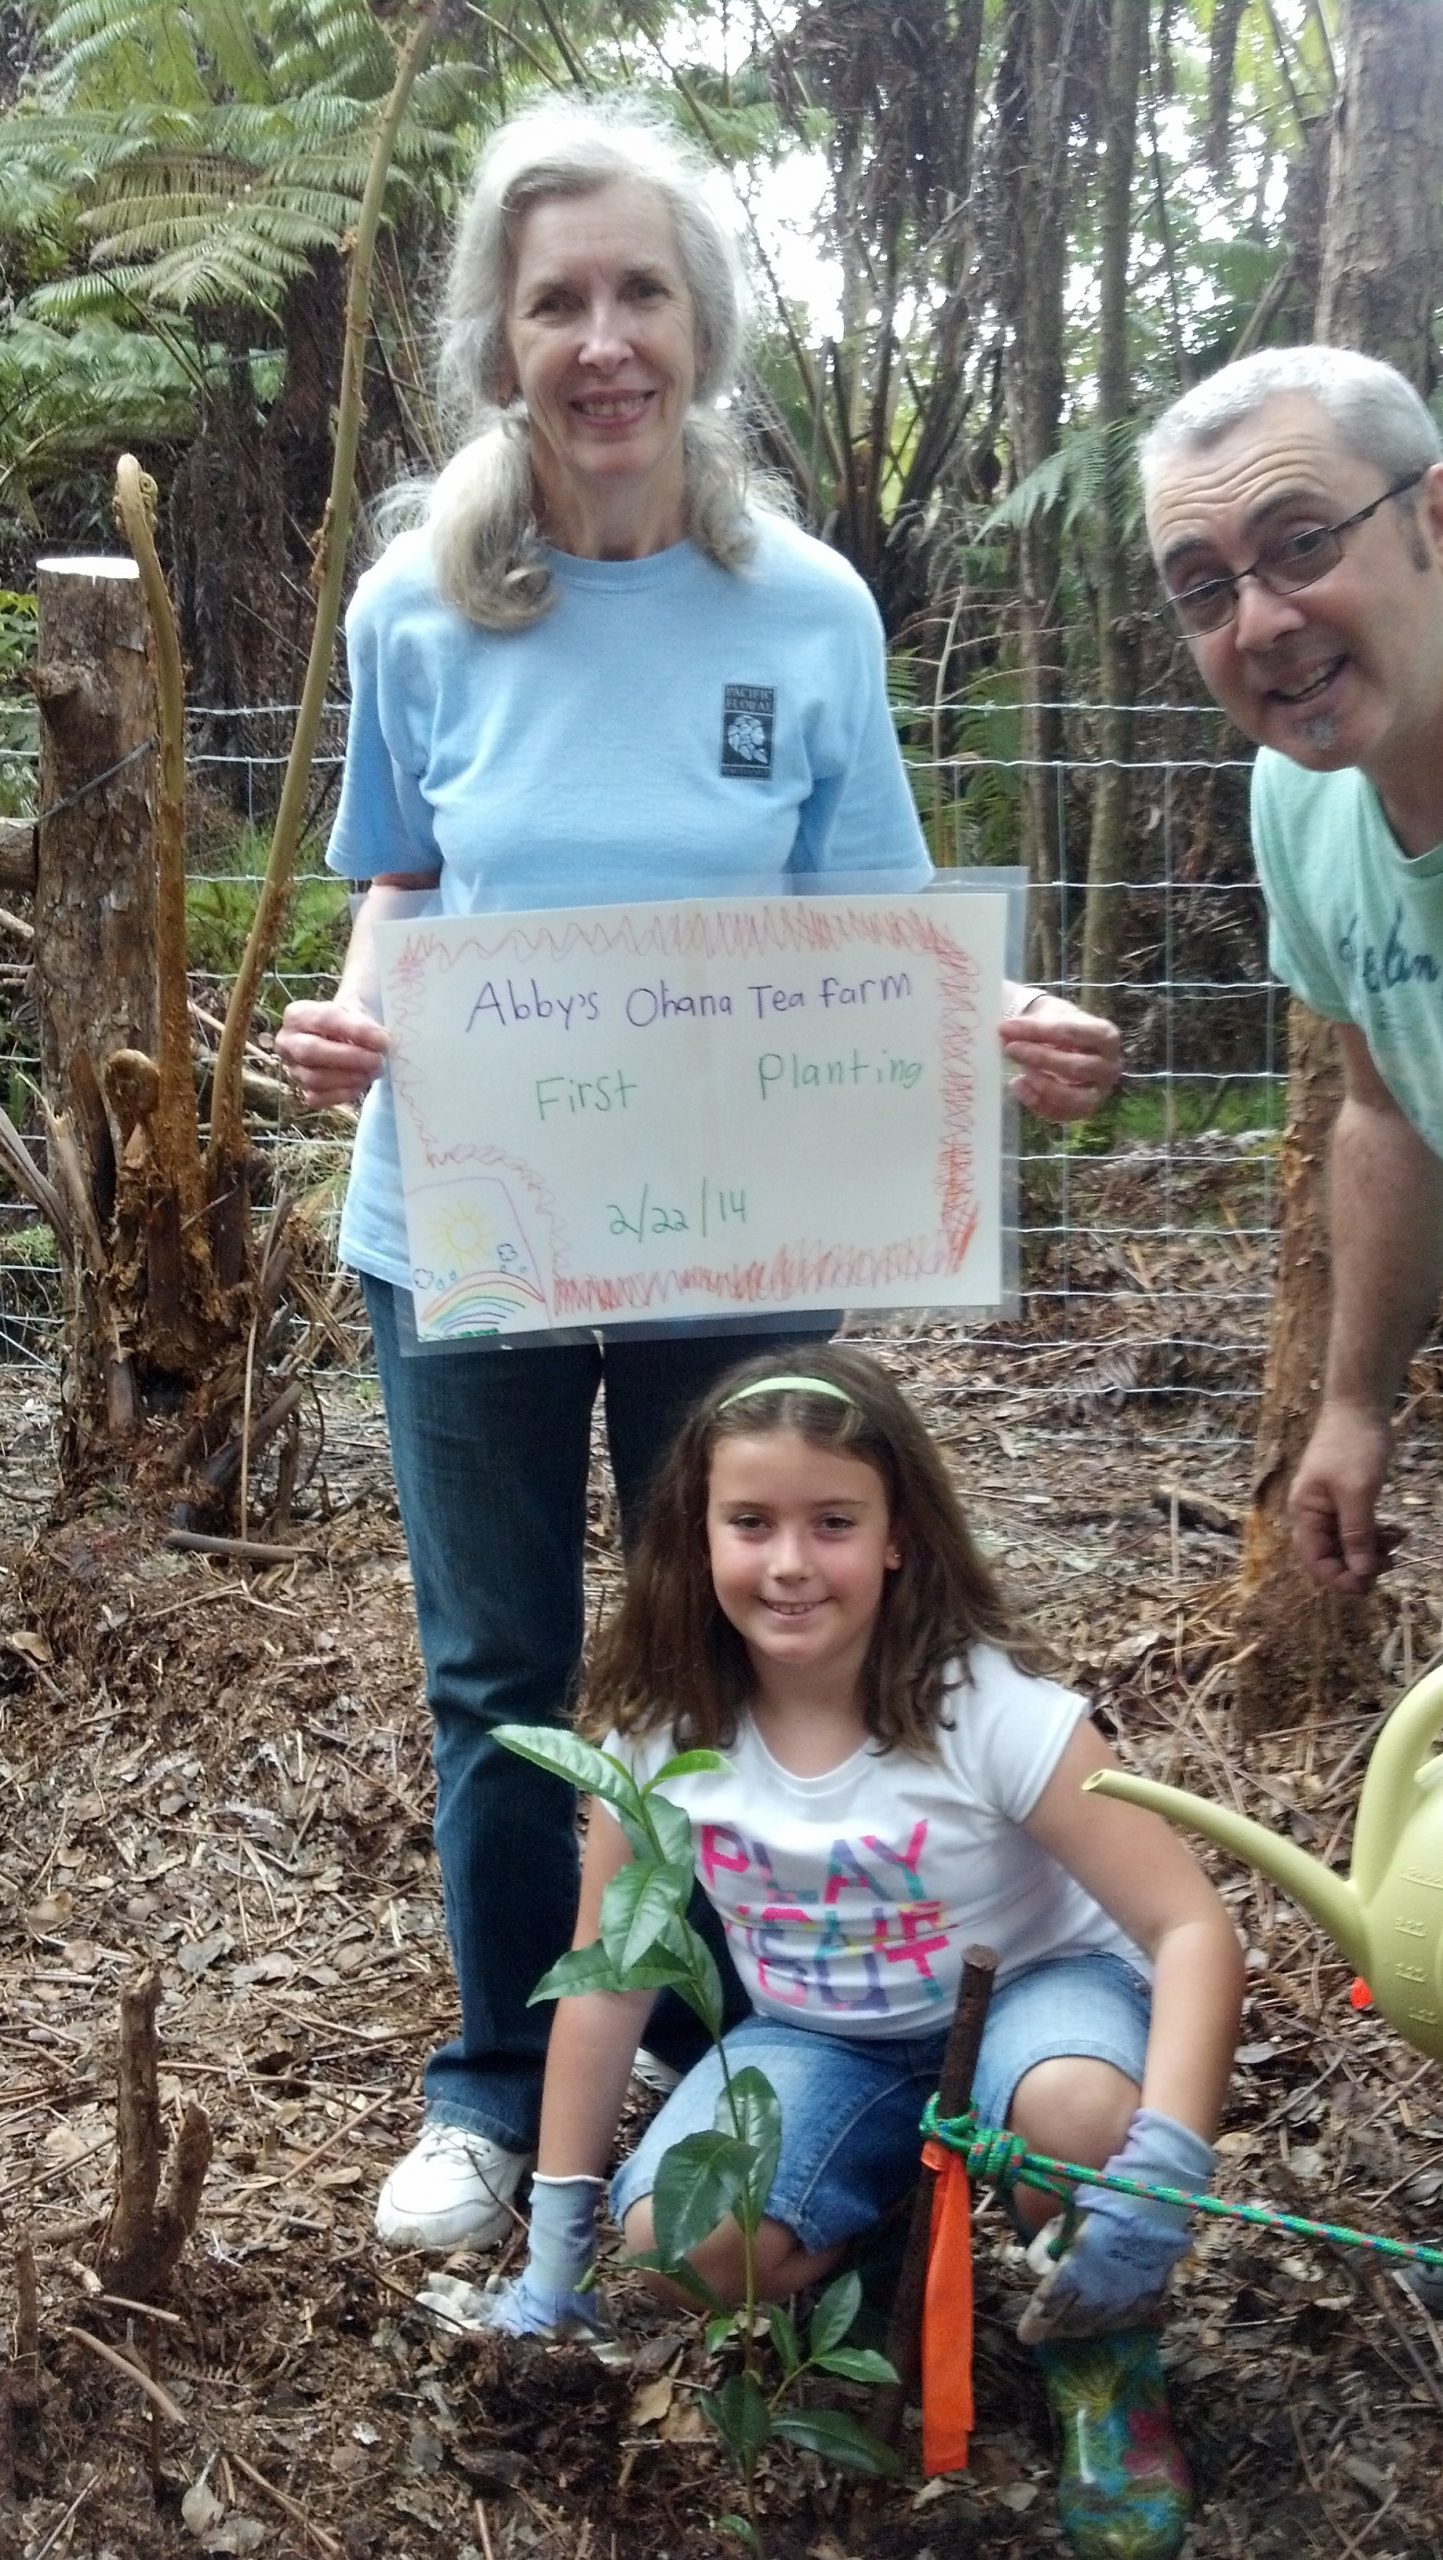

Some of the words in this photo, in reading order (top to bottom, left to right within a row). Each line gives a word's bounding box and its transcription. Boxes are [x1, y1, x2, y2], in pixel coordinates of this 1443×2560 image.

[466, 980, 599, 1031] Abby's
[625, 979, 733, 1027] Ohana
[747, 984, 806, 1020] Tea
[535, 1070, 638, 1120] First
[758, 1048, 922, 1100] Planting
[607, 1177, 746, 1242] 2/22/14
[701, 1819, 928, 1904] PLAY
